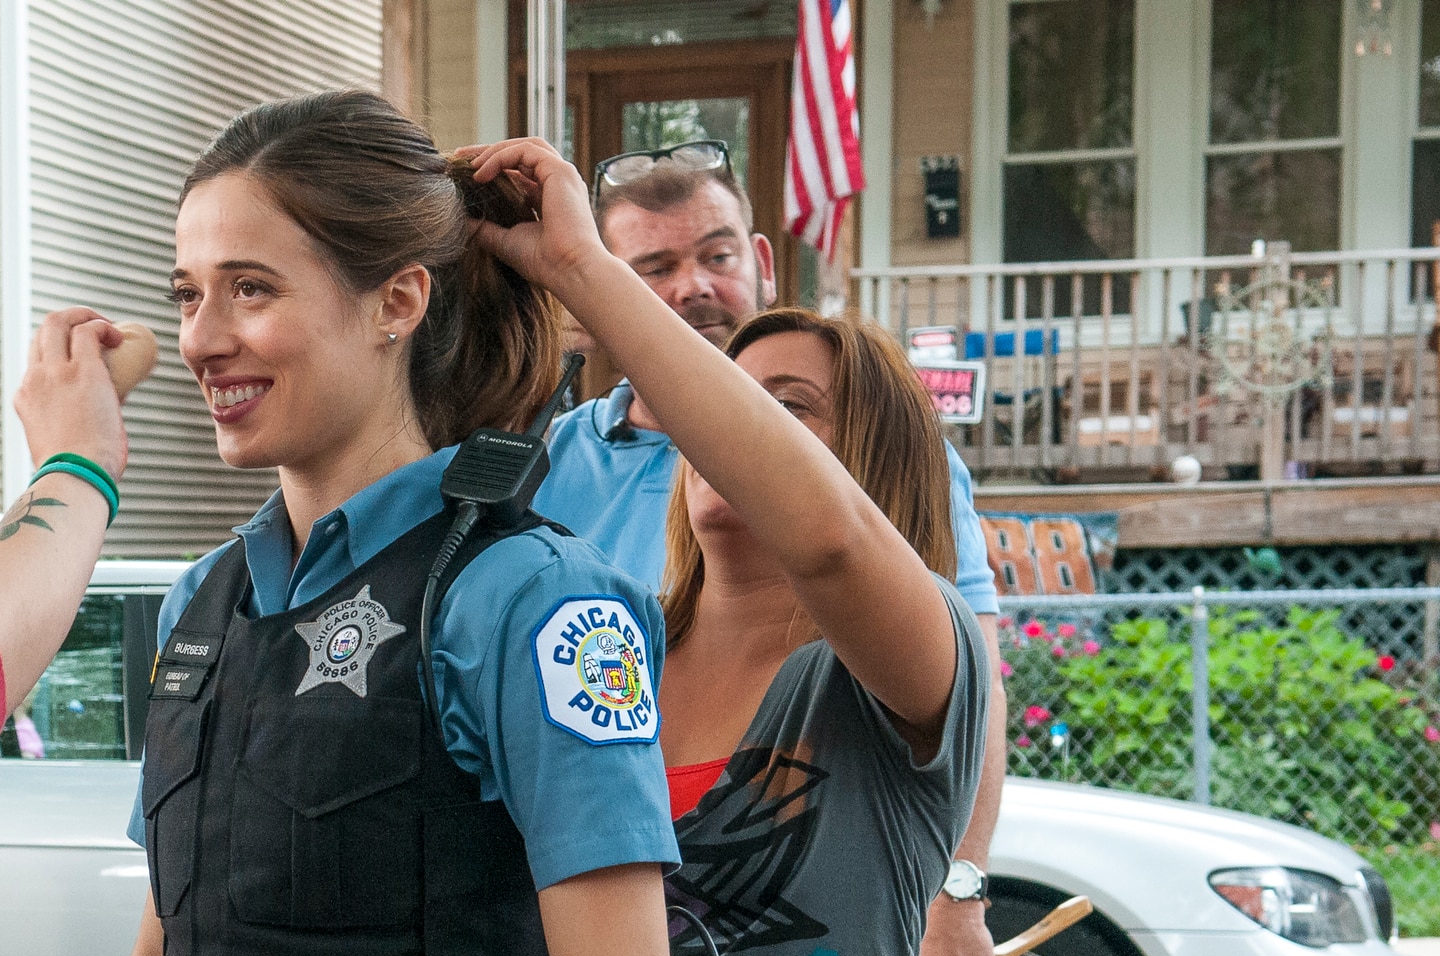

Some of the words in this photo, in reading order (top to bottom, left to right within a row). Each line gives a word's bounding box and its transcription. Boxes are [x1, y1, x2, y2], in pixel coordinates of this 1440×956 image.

[488, 437, 533, 449] MOTOROLA
[324, 600, 356, 620] POLICE
[358, 600, 386, 620] OFFICER
[313, 610, 358, 652] CHICAGO
[361, 612, 378, 651] POLICE
[553, 607, 644, 666] CHICAGO
[174, 642, 209, 656] BURGESS
[568, 689, 652, 731] POLICE
